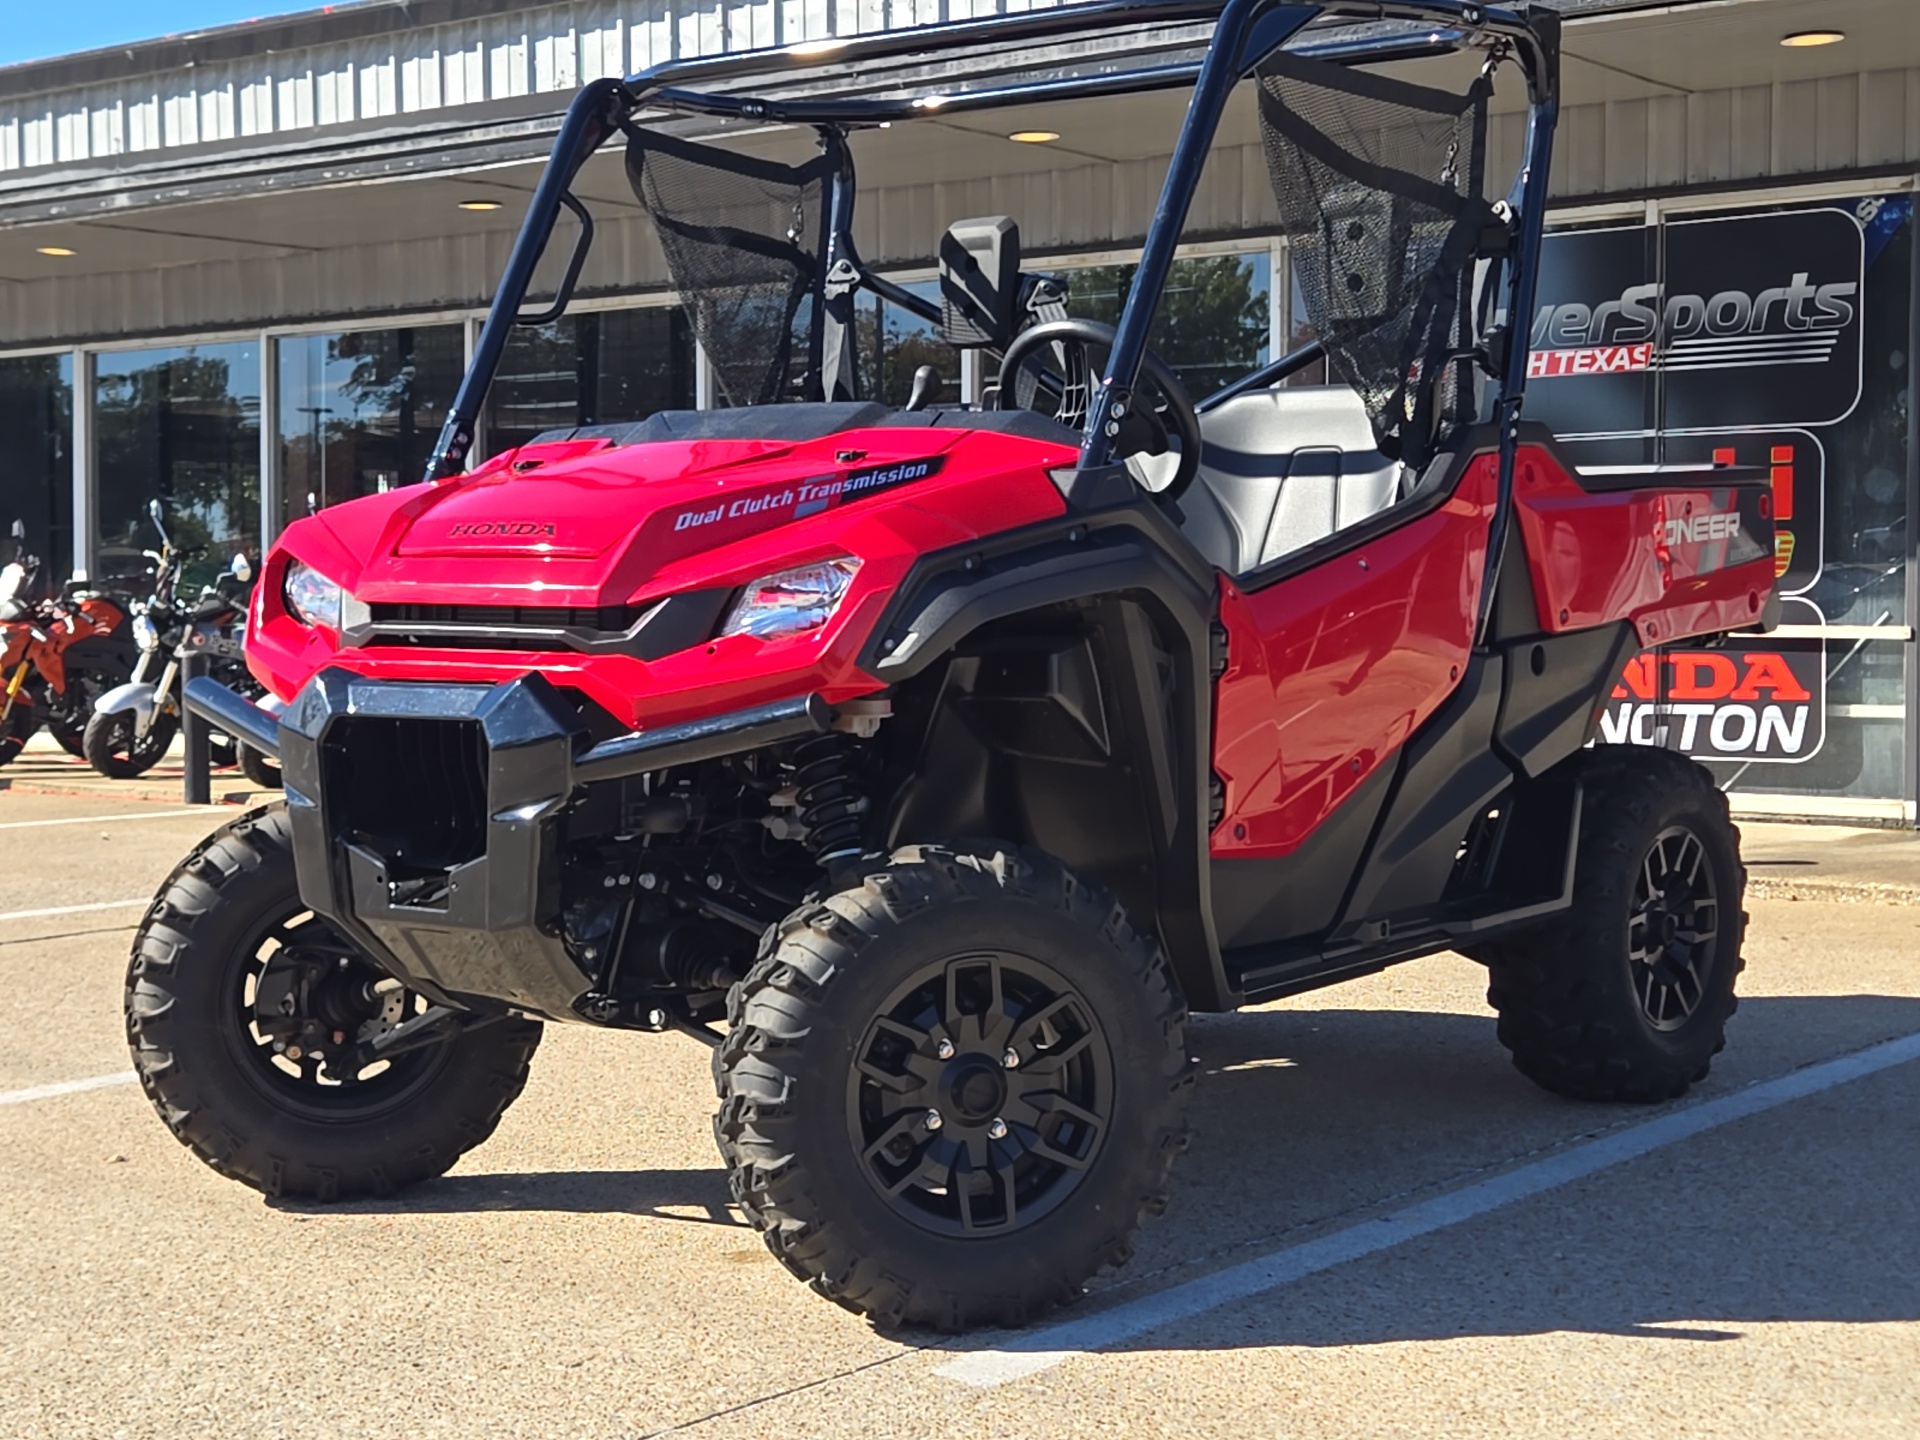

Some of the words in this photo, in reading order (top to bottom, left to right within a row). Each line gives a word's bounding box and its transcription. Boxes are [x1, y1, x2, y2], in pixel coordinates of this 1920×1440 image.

[1555, 346, 1651, 374] TEXAS
[674, 505, 724, 531] Dual
[728, 490, 795, 518] Clutch
[797, 462, 928, 503] Transmission
[450, 523, 555, 536] HONDA
